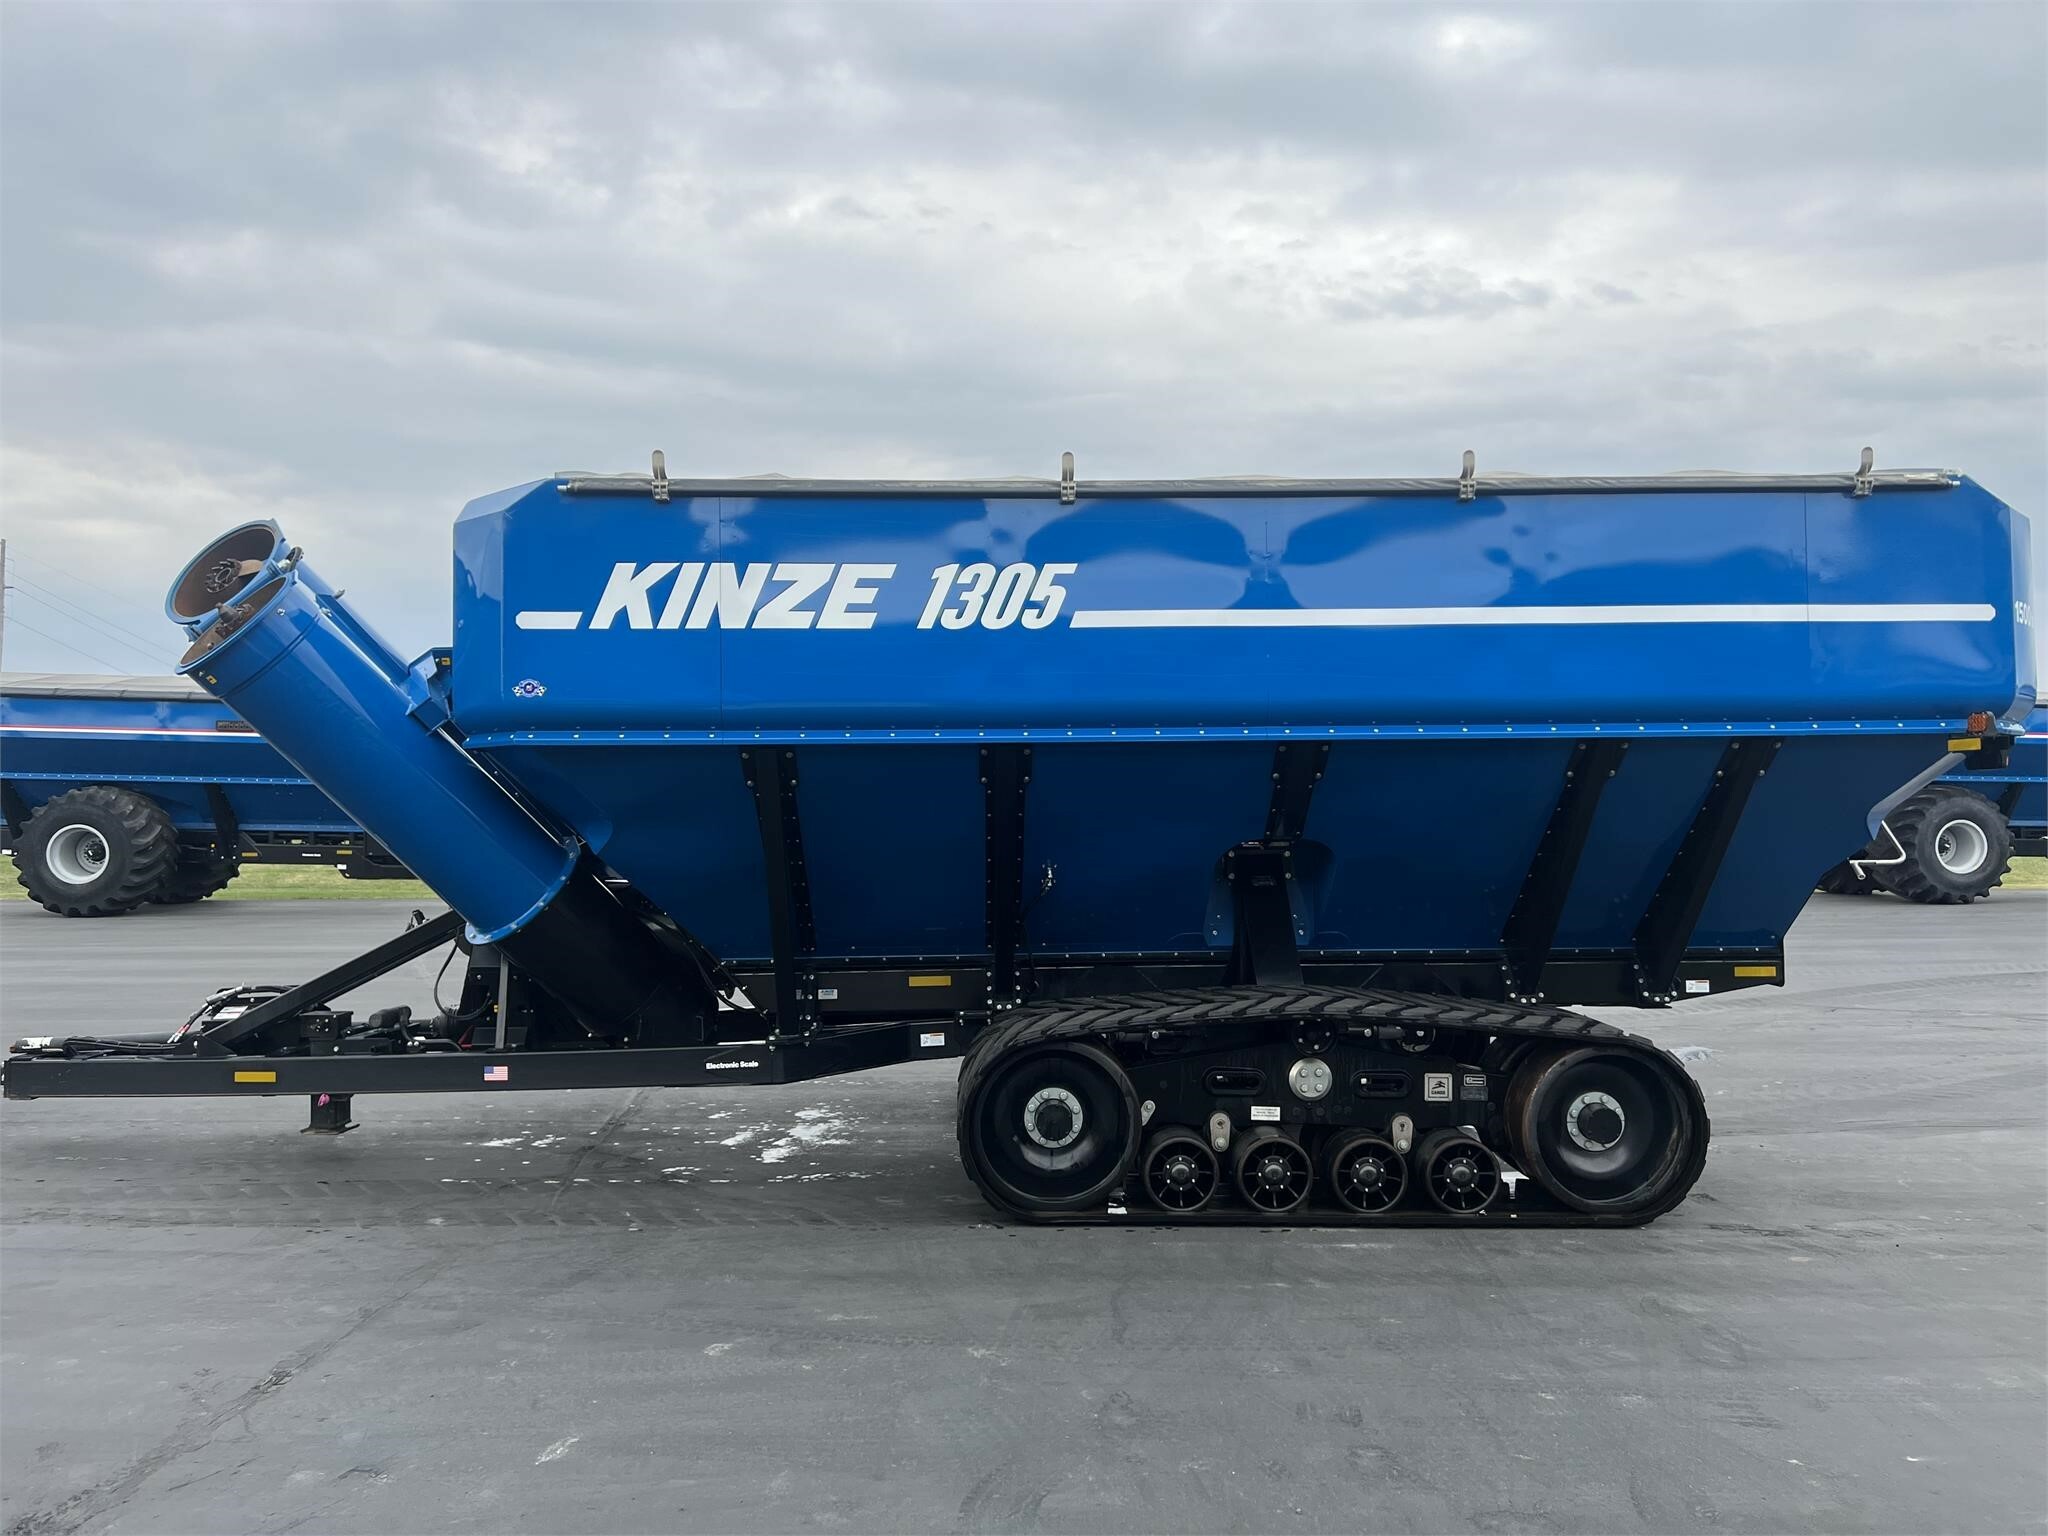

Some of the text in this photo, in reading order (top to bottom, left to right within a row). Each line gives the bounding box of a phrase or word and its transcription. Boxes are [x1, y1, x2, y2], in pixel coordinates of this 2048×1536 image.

[588, 562, 1078, 630] KINZE 1305
[705, 1060, 759, 1070] Electronic Scale
